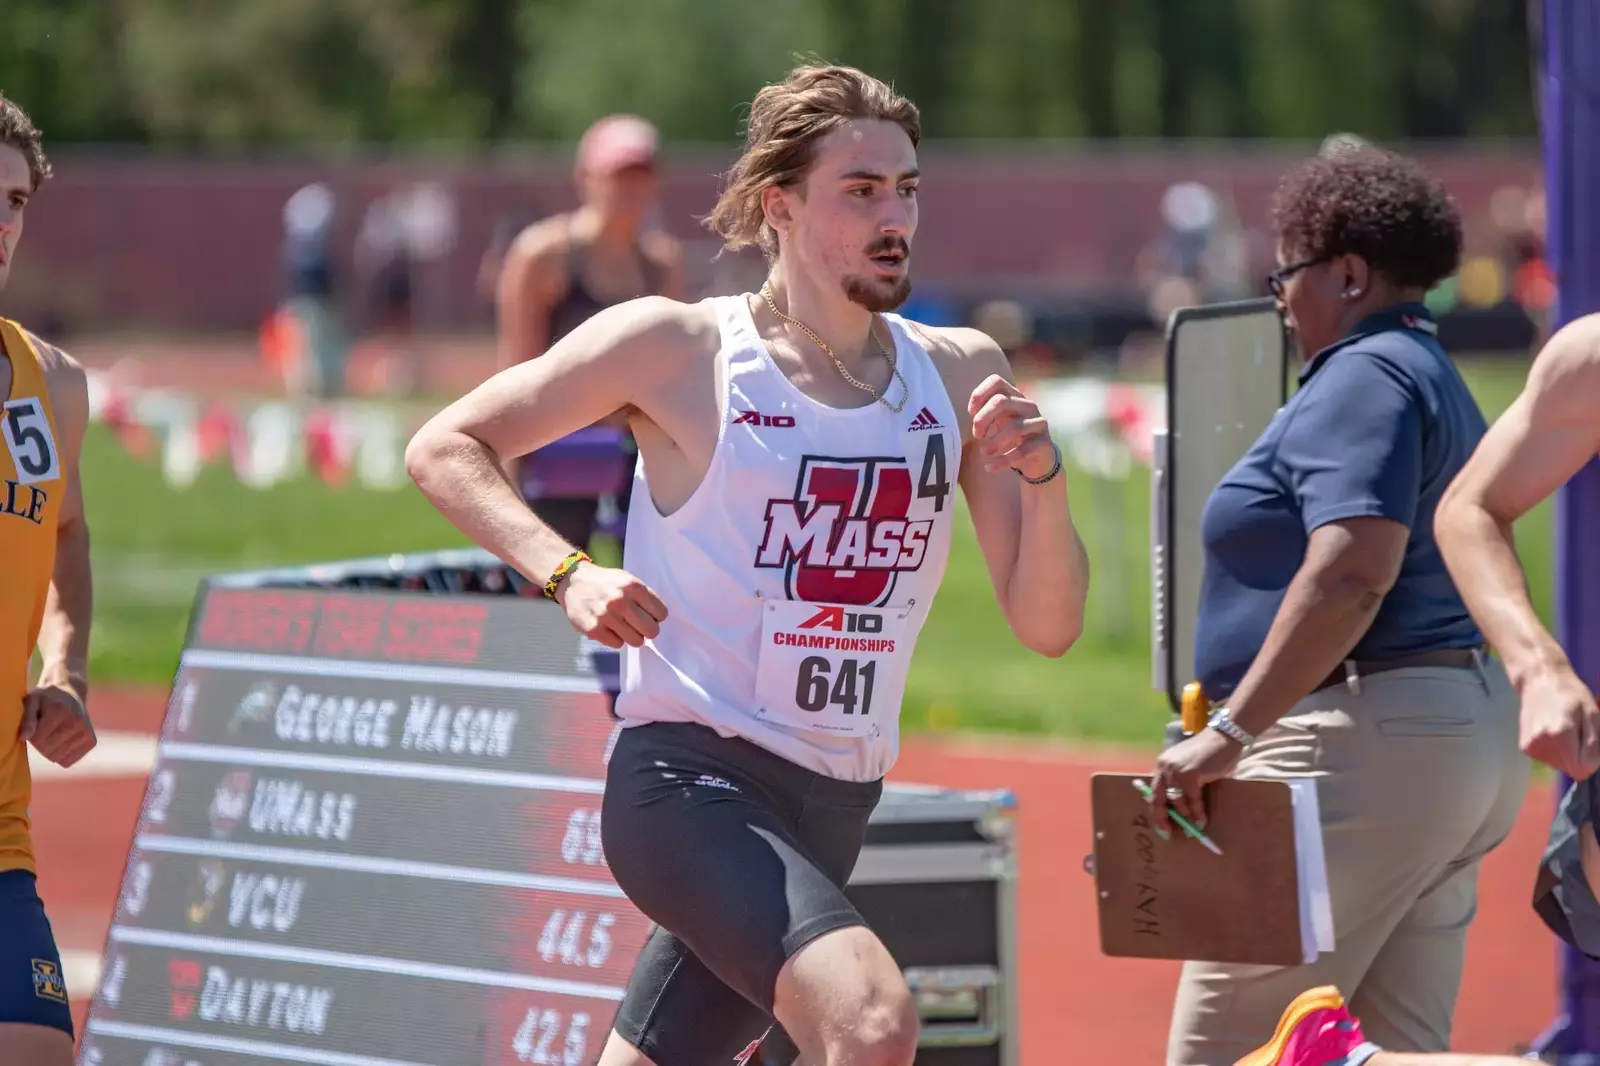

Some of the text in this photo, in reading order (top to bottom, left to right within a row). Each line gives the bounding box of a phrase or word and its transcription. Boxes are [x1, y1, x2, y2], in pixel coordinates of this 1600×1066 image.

[7, 404, 51, 475] 5
[731, 411, 796, 428] A10
[0, 479, 47, 525] LE
[917, 434, 950, 512] 4
[773, 632, 895, 653] CHAMPIONSHIPS
[796, 606, 883, 633] A10
[795, 655, 876, 716] 641
[274, 684, 398, 748] GEORGE
[400, 695, 518, 756] MASON
[248, 778, 358, 841] UMASS
[228, 871, 306, 932] VCU
[536, 909, 617, 968] 44.5
[199, 966, 333, 1036] DAYTON
[511, 1007, 591, 1066] 42.5
